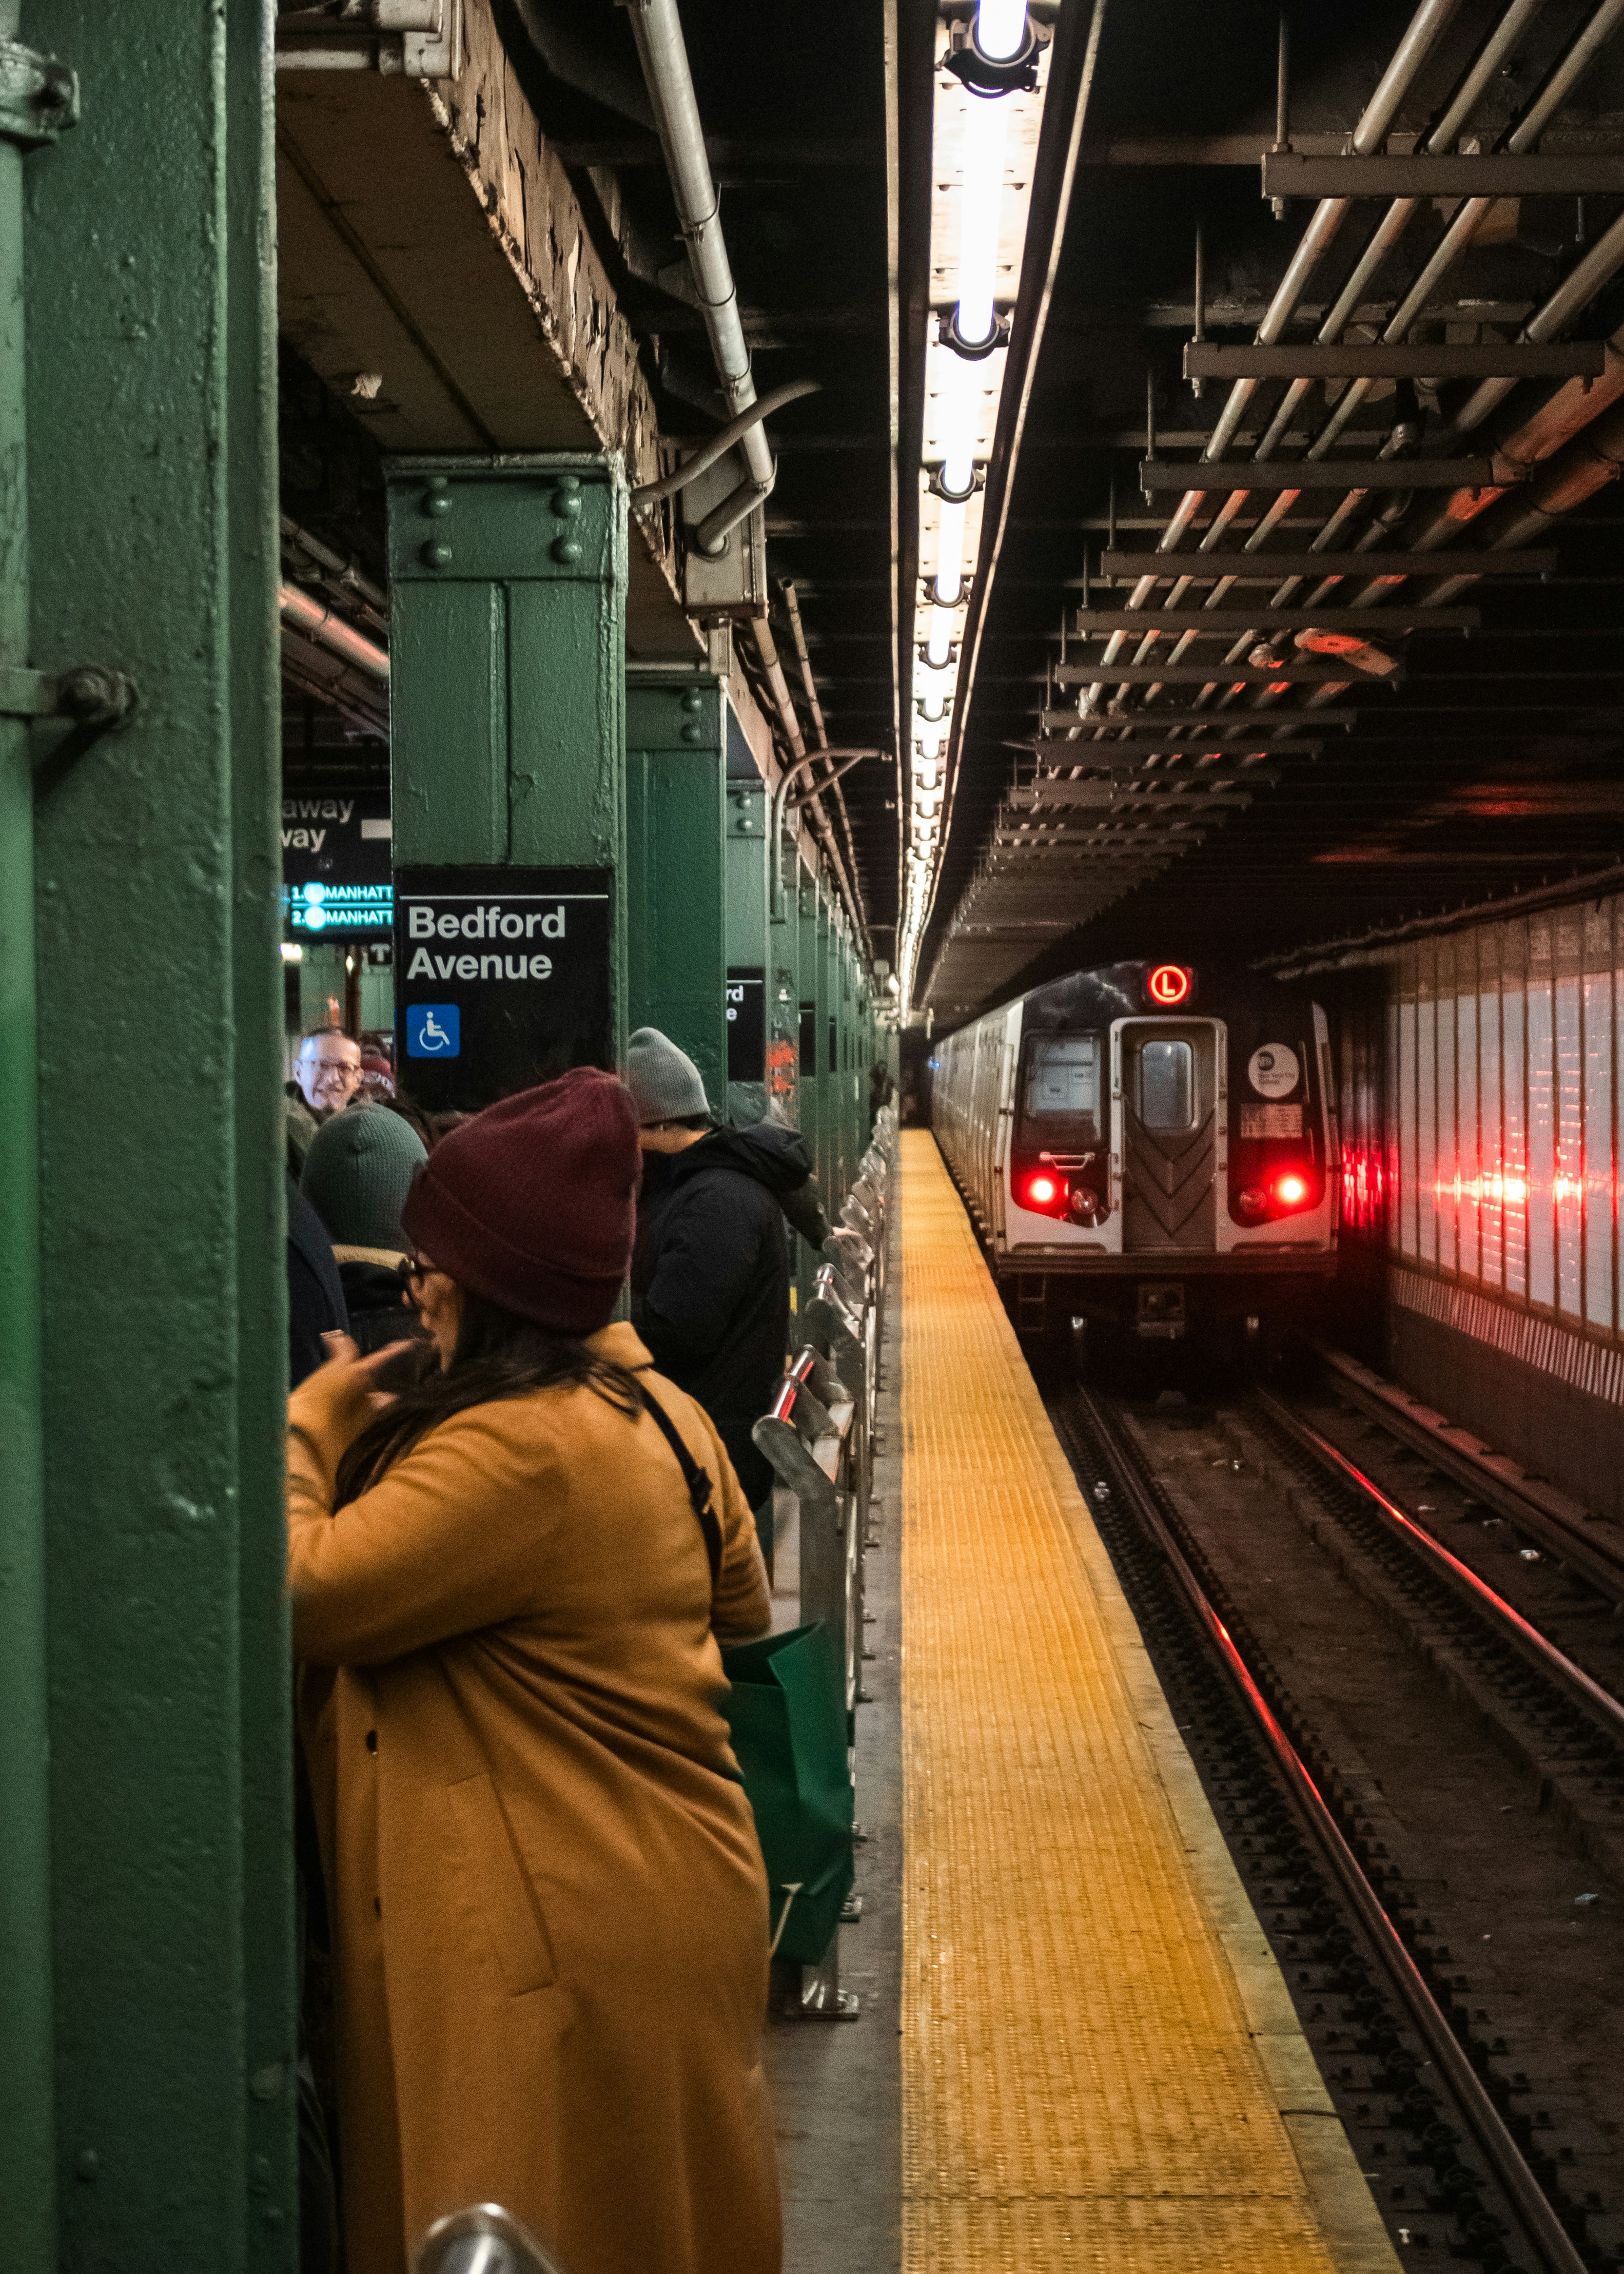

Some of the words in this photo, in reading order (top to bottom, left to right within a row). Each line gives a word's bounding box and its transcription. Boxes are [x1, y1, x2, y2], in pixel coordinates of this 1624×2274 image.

[409, 906, 565, 938] Bedford
[407, 947, 553, 980] Avenue
[1162, 973, 1176, 996] L
